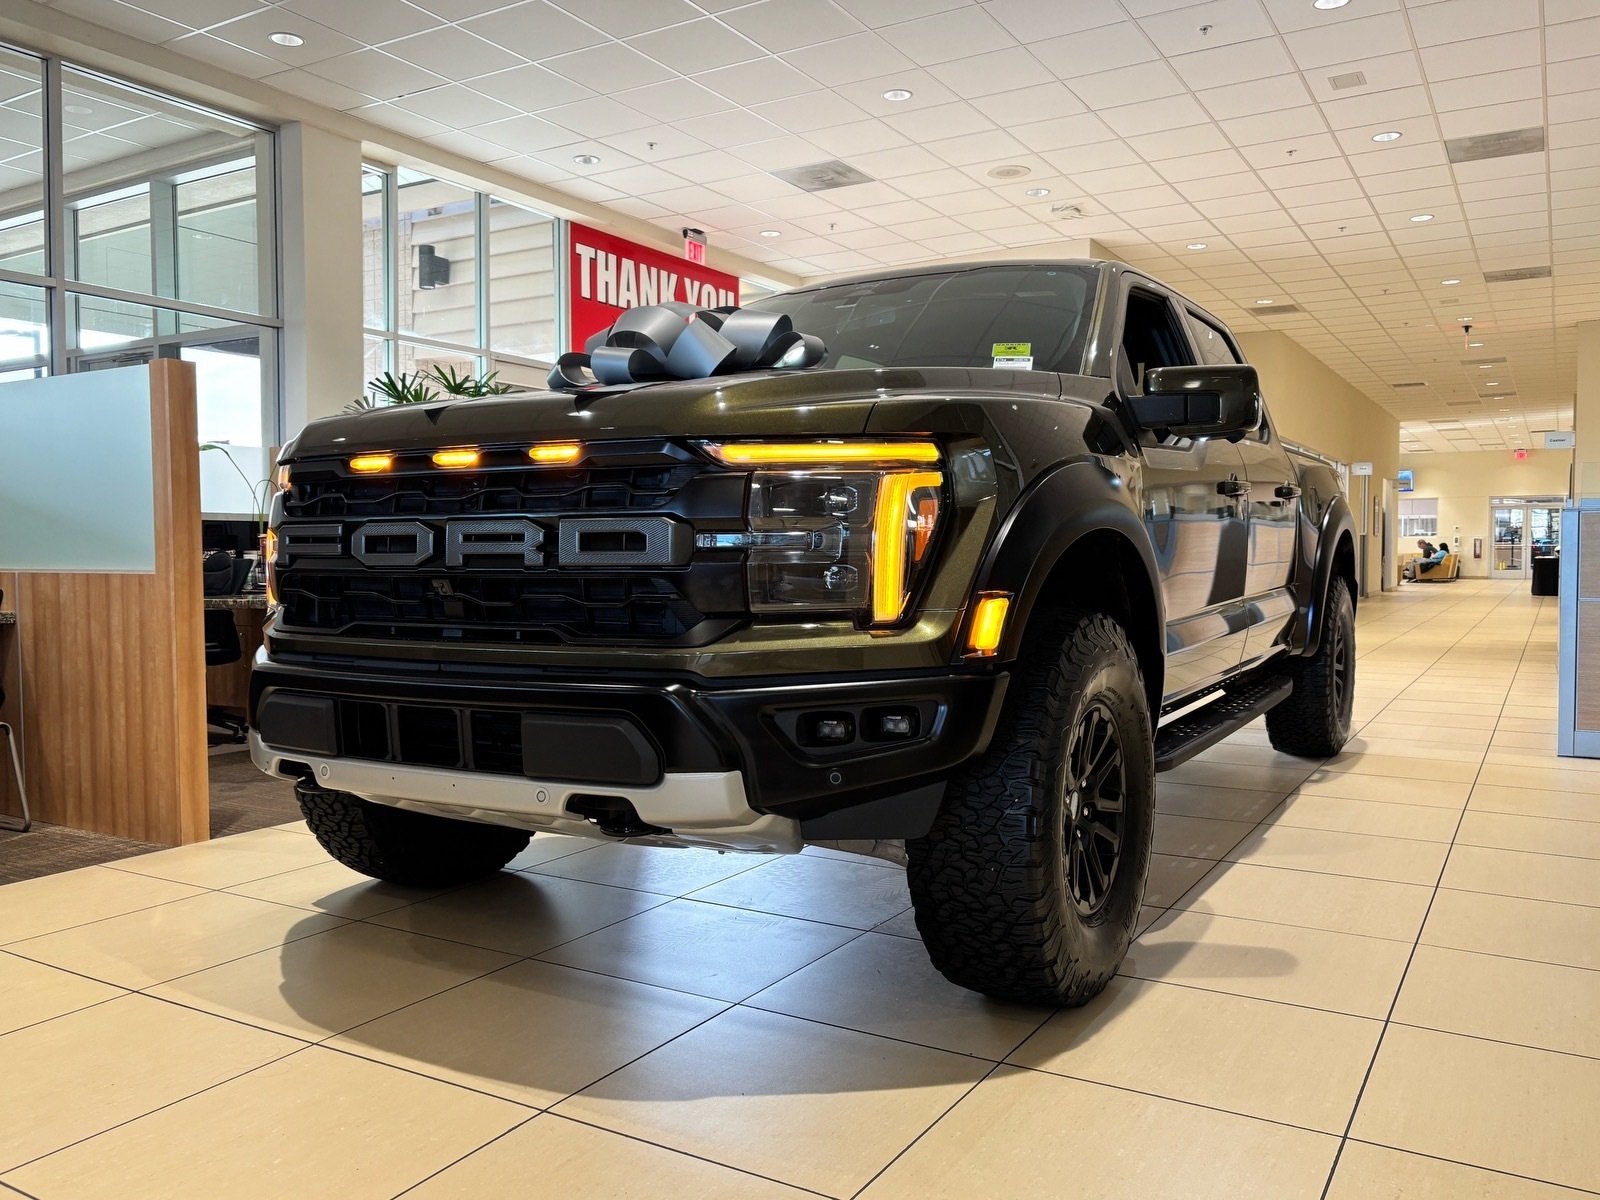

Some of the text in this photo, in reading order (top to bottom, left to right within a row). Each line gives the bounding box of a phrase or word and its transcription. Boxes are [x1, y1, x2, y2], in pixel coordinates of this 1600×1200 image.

[575, 242, 678, 309] THANK
[688, 240, 703, 263] EXIT
[278, 516, 694, 568] FORD
